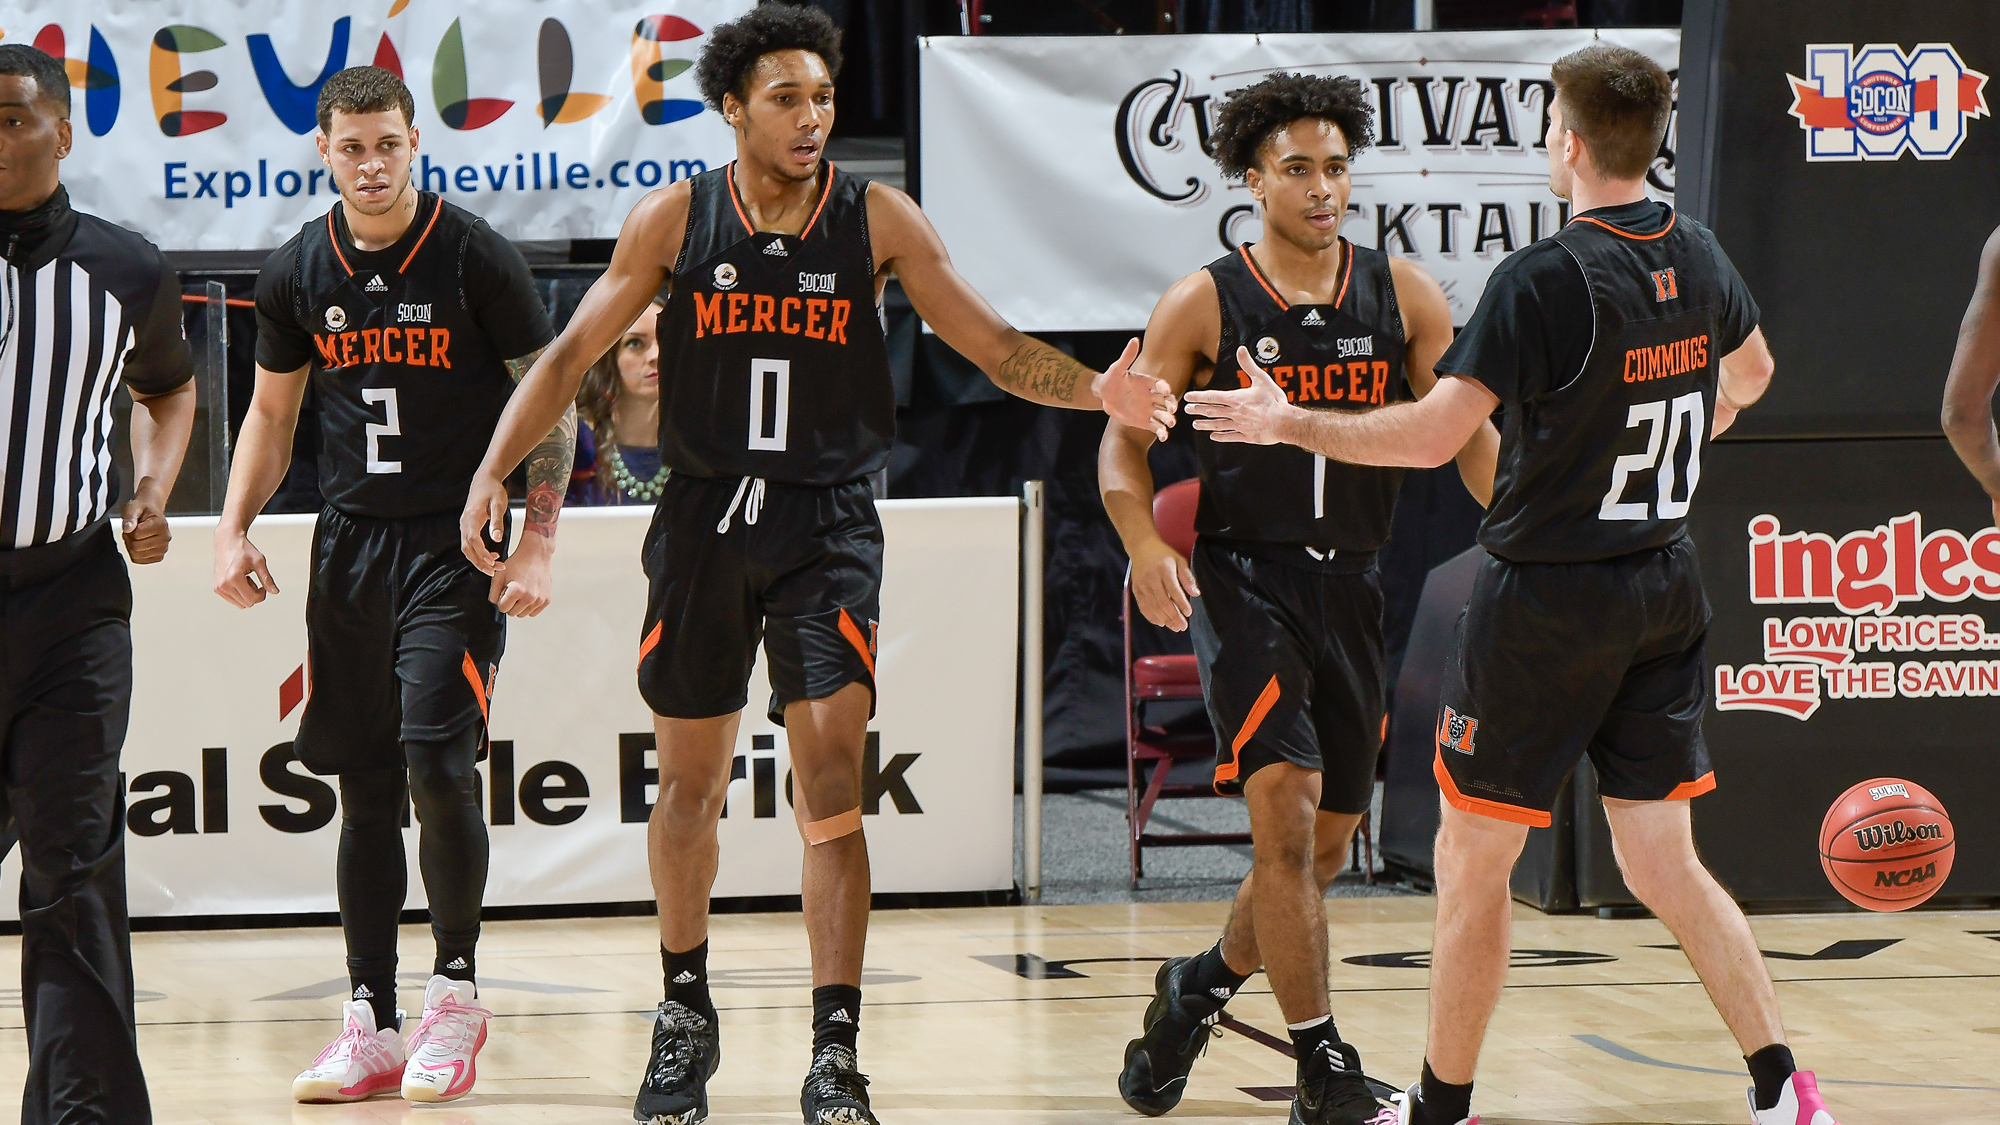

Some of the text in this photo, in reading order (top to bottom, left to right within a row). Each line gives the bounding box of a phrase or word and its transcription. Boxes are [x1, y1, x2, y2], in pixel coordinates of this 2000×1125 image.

[0, 14, 704, 137] HEVLLE
[1850, 84, 1912, 118] SOCON
[164, 151, 706, 208] Explorheville.com
[762, 248, 789, 257] adidas
[798, 271, 837, 294] SOCON
[397, 303, 432, 323] SOCON
[693, 292, 851, 345] MERCER
[1301, 319, 1326, 327] adidas
[314, 327, 451, 369] MERCER
[1336, 335, 1373, 358] SOCON
[1623, 334, 1708, 383] CUMMINGS
[748, 357, 791, 452] 0
[361, 387, 402, 474] 2
[1598, 391, 1705, 520] 20
[1750, 514, 2000, 613] ingles
[1768, 622, 1848, 648] LOW
[1720, 666, 2000, 694] LOVE THE SAVIN
[258, 739, 590, 834] Sle
[619, 731, 924, 823] Bik
[1854, 820, 1942, 851] Wilson
[1874, 862, 1936, 887] NCAA
[672, 975, 697, 984] adidas
[828, 1015, 853, 1024] adidas
